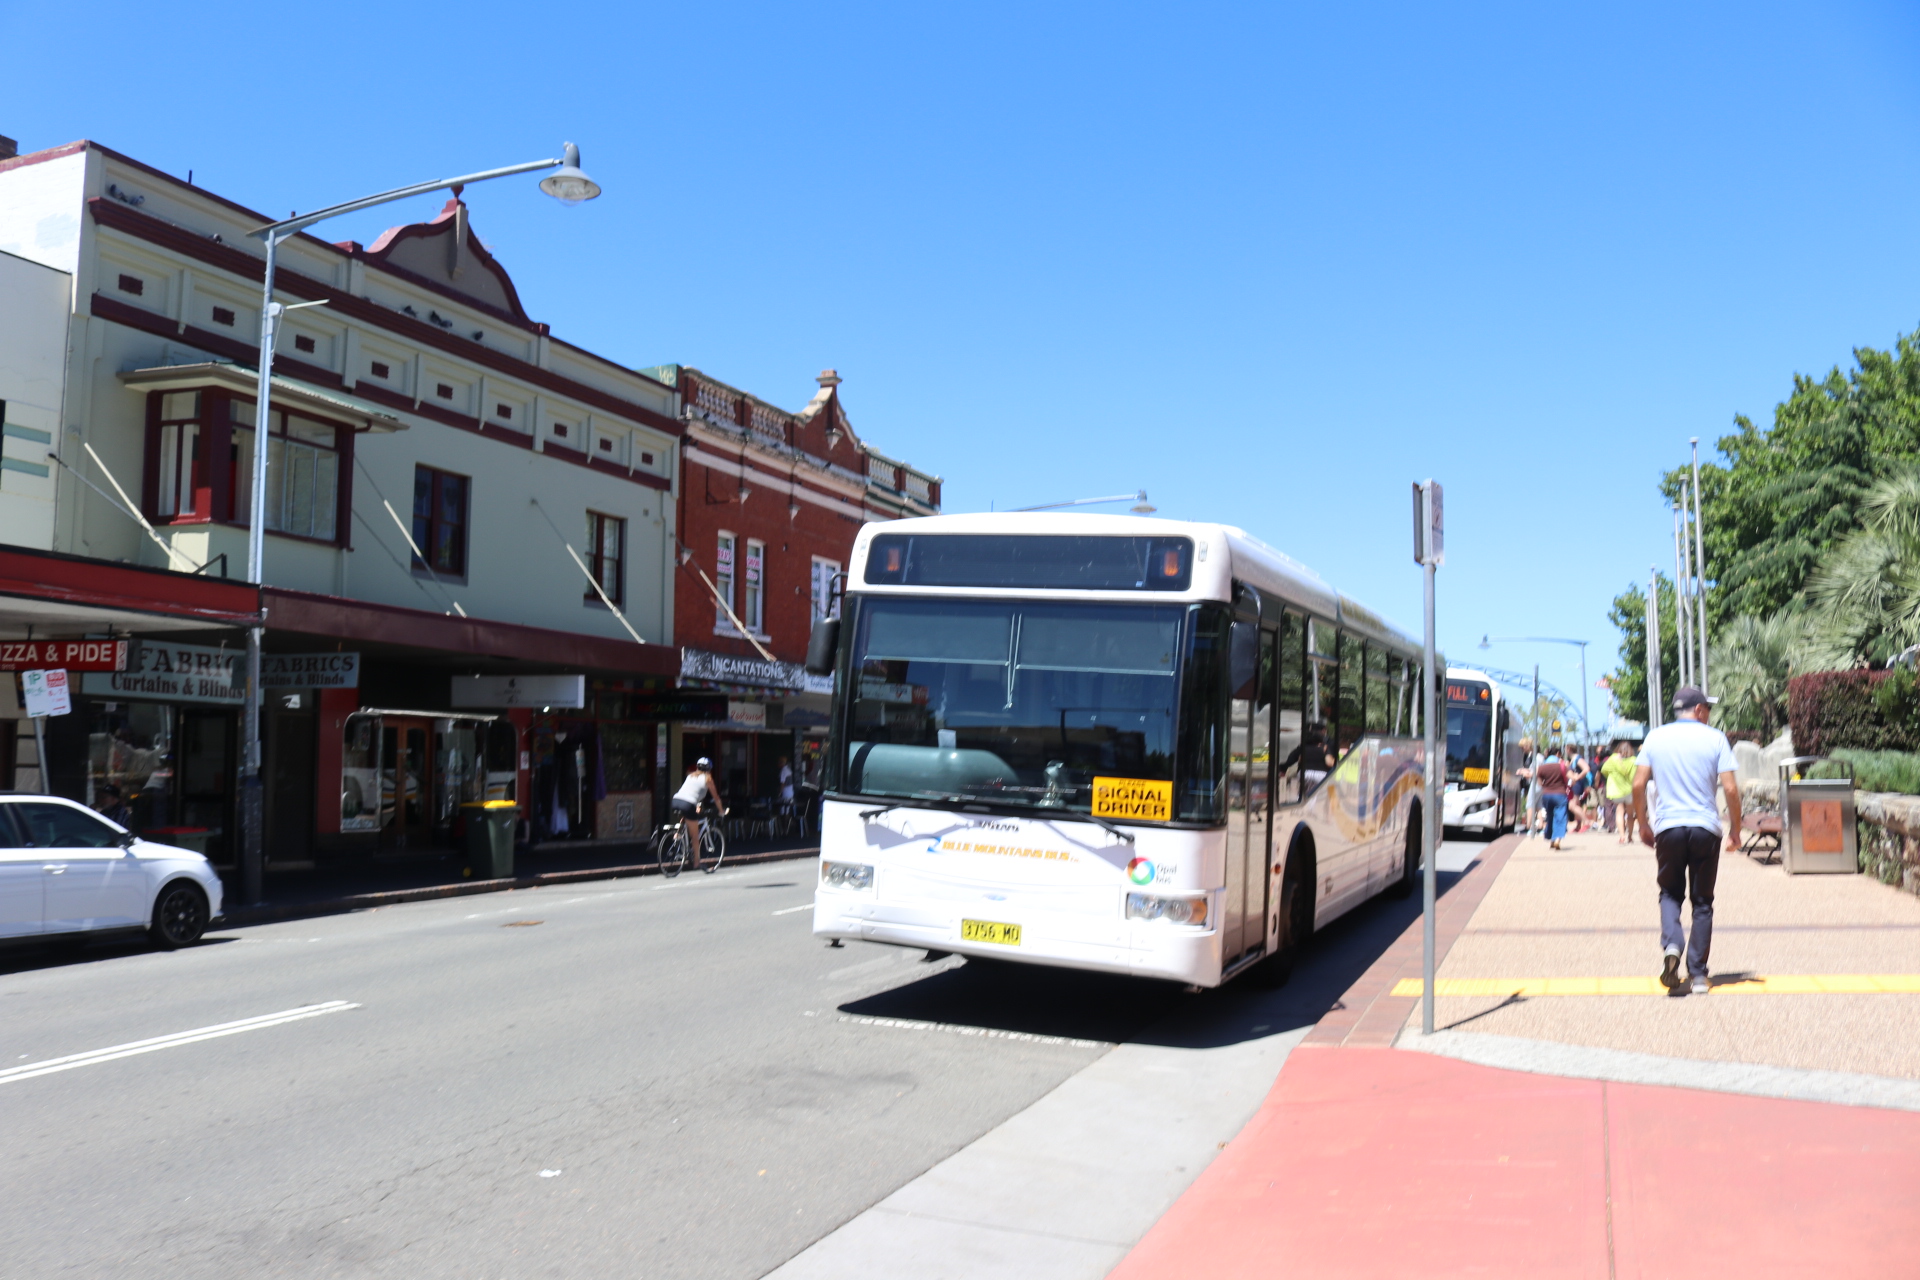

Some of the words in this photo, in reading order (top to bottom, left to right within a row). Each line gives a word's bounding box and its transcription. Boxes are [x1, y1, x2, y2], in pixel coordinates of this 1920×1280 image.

[45, 643, 58, 662] &
[66, 643, 113, 662] PIDE
[140, 646, 234, 678] FABRIC
[260, 655, 355, 673] FABRICS
[711, 654, 784, 679] INCANTATIONS
[111, 671, 178, 694] Curtains
[182, 677, 194, 695] &
[198, 677, 244, 699] Blinds
[259, 673, 292, 686] rtains
[294, 672, 304, 685] &
[307, 672, 345, 685] Blinds
[1446, 685, 1468, 700] FULL
[1098, 785, 1167, 803] SIGNAL
[1098, 801, 1166, 817] DRIVER
[942, 840, 972, 851] BLUE
[973, 843, 1043, 859] MOUNTAINS
[1044, 850, 1071, 861] BUS
